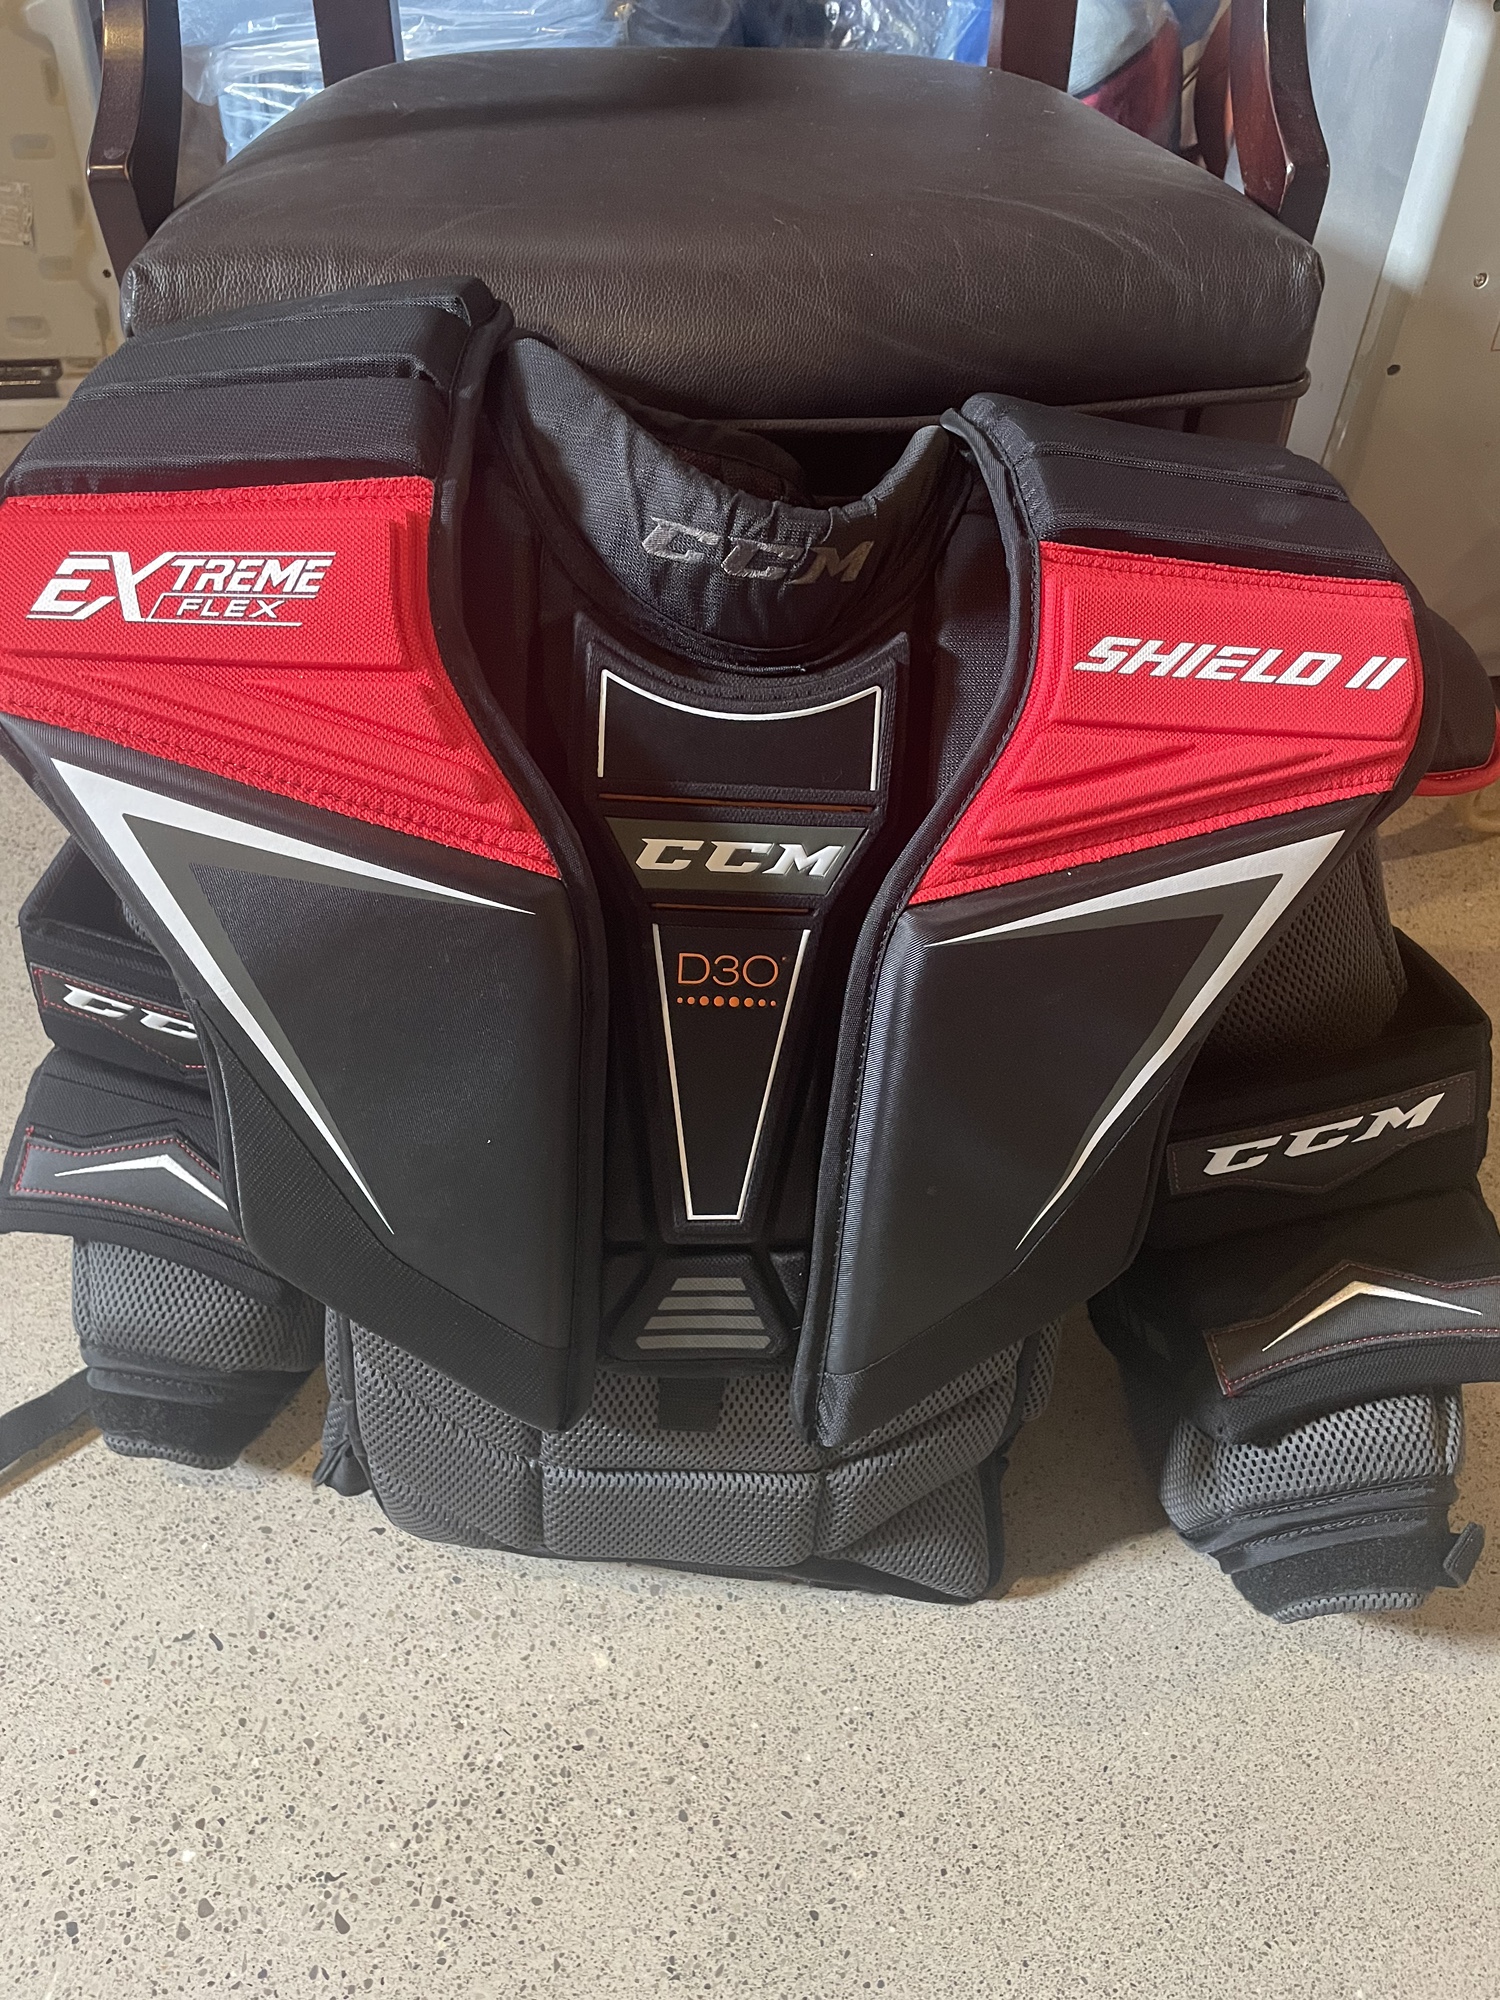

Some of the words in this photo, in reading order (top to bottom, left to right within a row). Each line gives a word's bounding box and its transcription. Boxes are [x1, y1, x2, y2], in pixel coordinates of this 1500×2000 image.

[641, 516, 874, 585] CCM
[26, 551, 336, 623] EXTREME
[176, 600, 286, 620] FLEX
[1073, 636, 1342, 687] SHIELD
[635, 838, 845, 877] CCM
[1203, 1092, 1445, 1176] CCM
